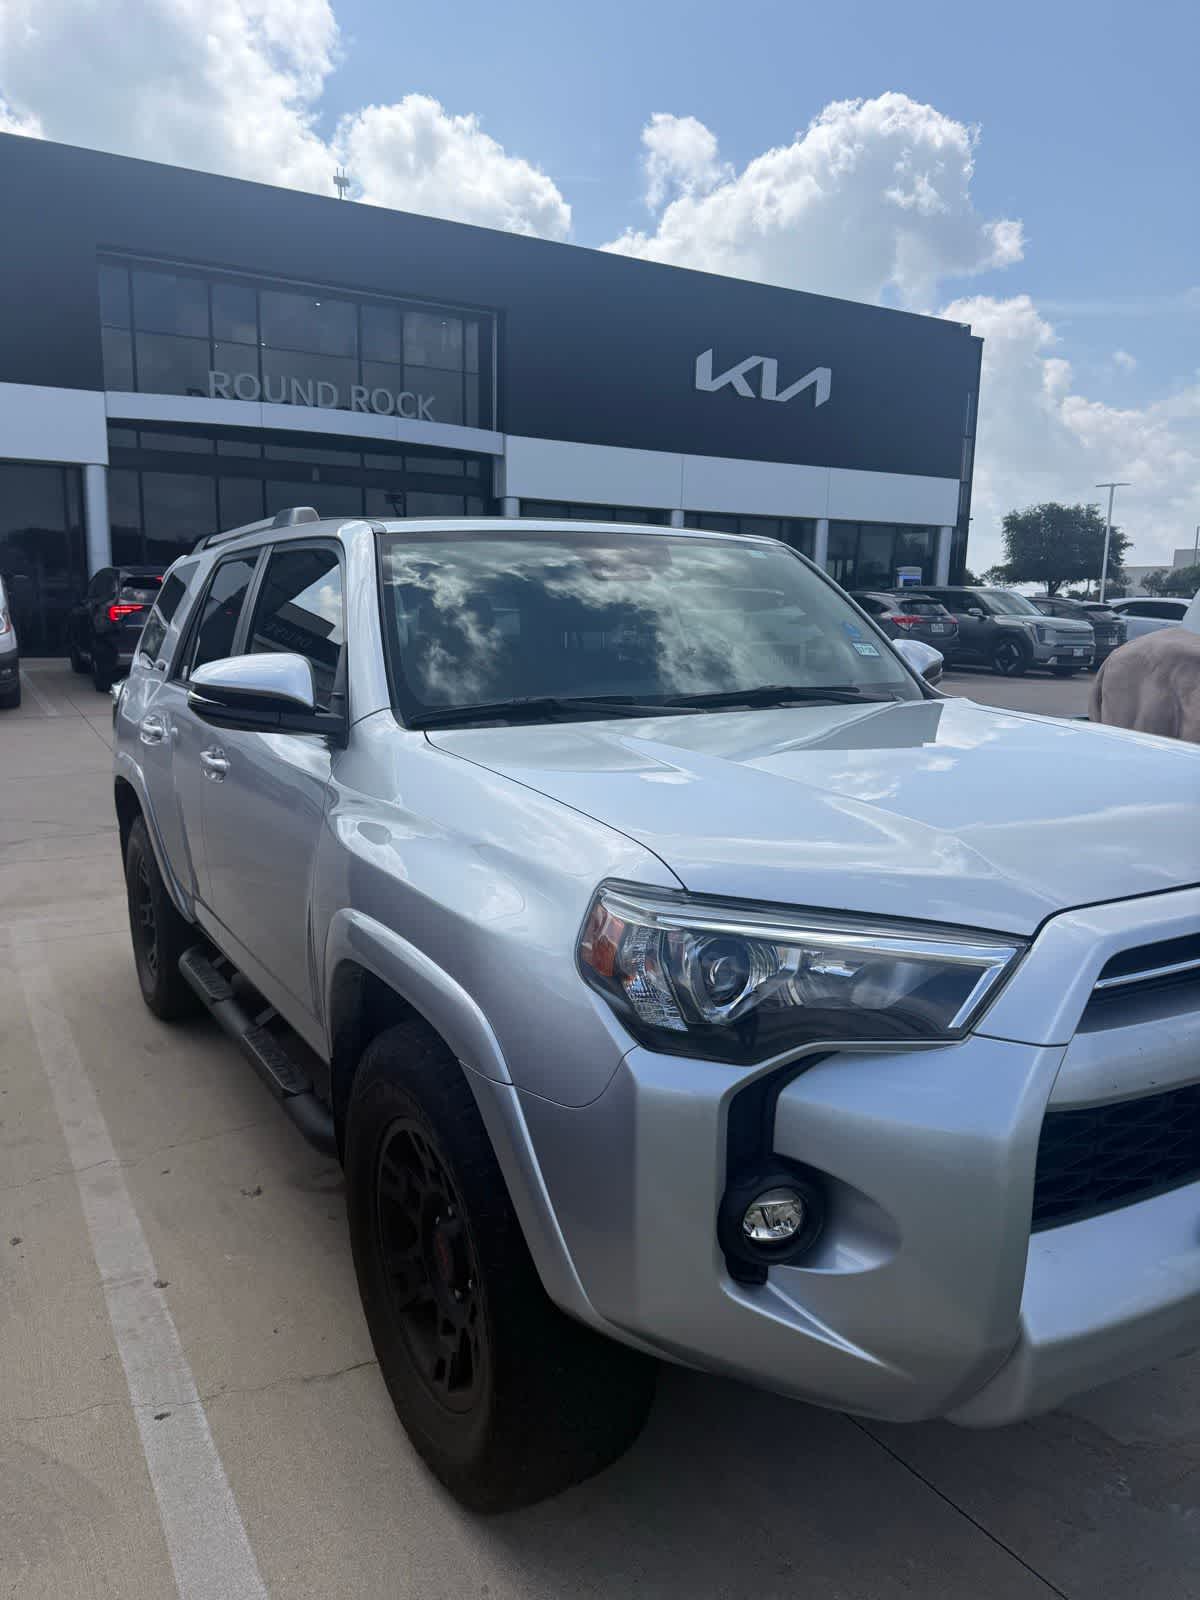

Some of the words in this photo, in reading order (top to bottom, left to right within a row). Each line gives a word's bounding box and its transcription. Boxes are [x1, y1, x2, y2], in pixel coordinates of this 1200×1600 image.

[208, 370, 337, 408] ROUND
[350, 384, 436, 421] ROCK
[695, 348, 832, 408] KIA
